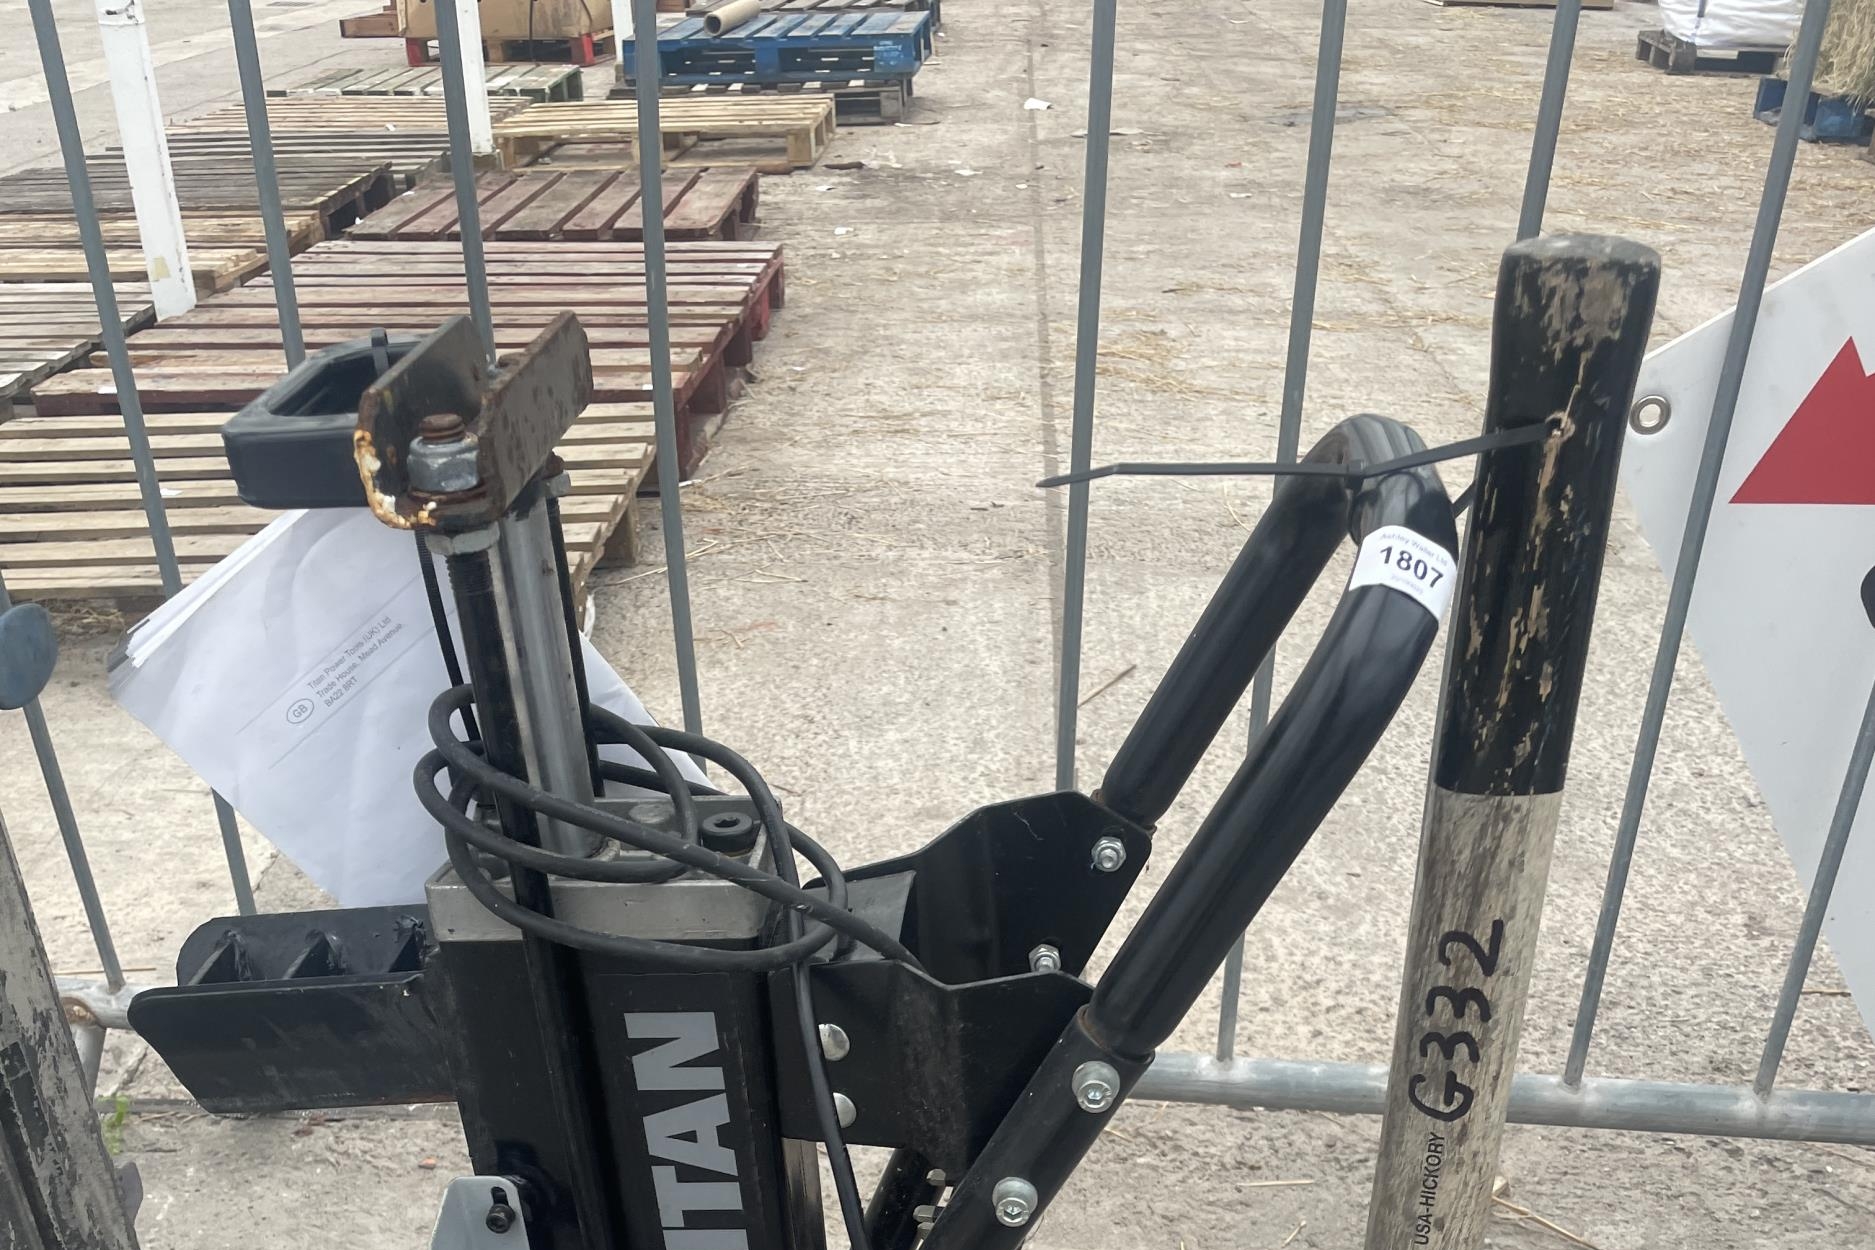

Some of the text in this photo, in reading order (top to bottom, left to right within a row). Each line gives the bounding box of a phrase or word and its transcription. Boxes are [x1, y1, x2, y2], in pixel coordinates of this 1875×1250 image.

[1379, 546, 1444, 588] 1807
[323, 655, 346, 676] Power
[292, 704, 308, 719] GB
[324, 688, 345, 708] BA22
[1408, 919, 1504, 1122] G332
[1414, 1132, 1445, 1245] USA-HICKORY
